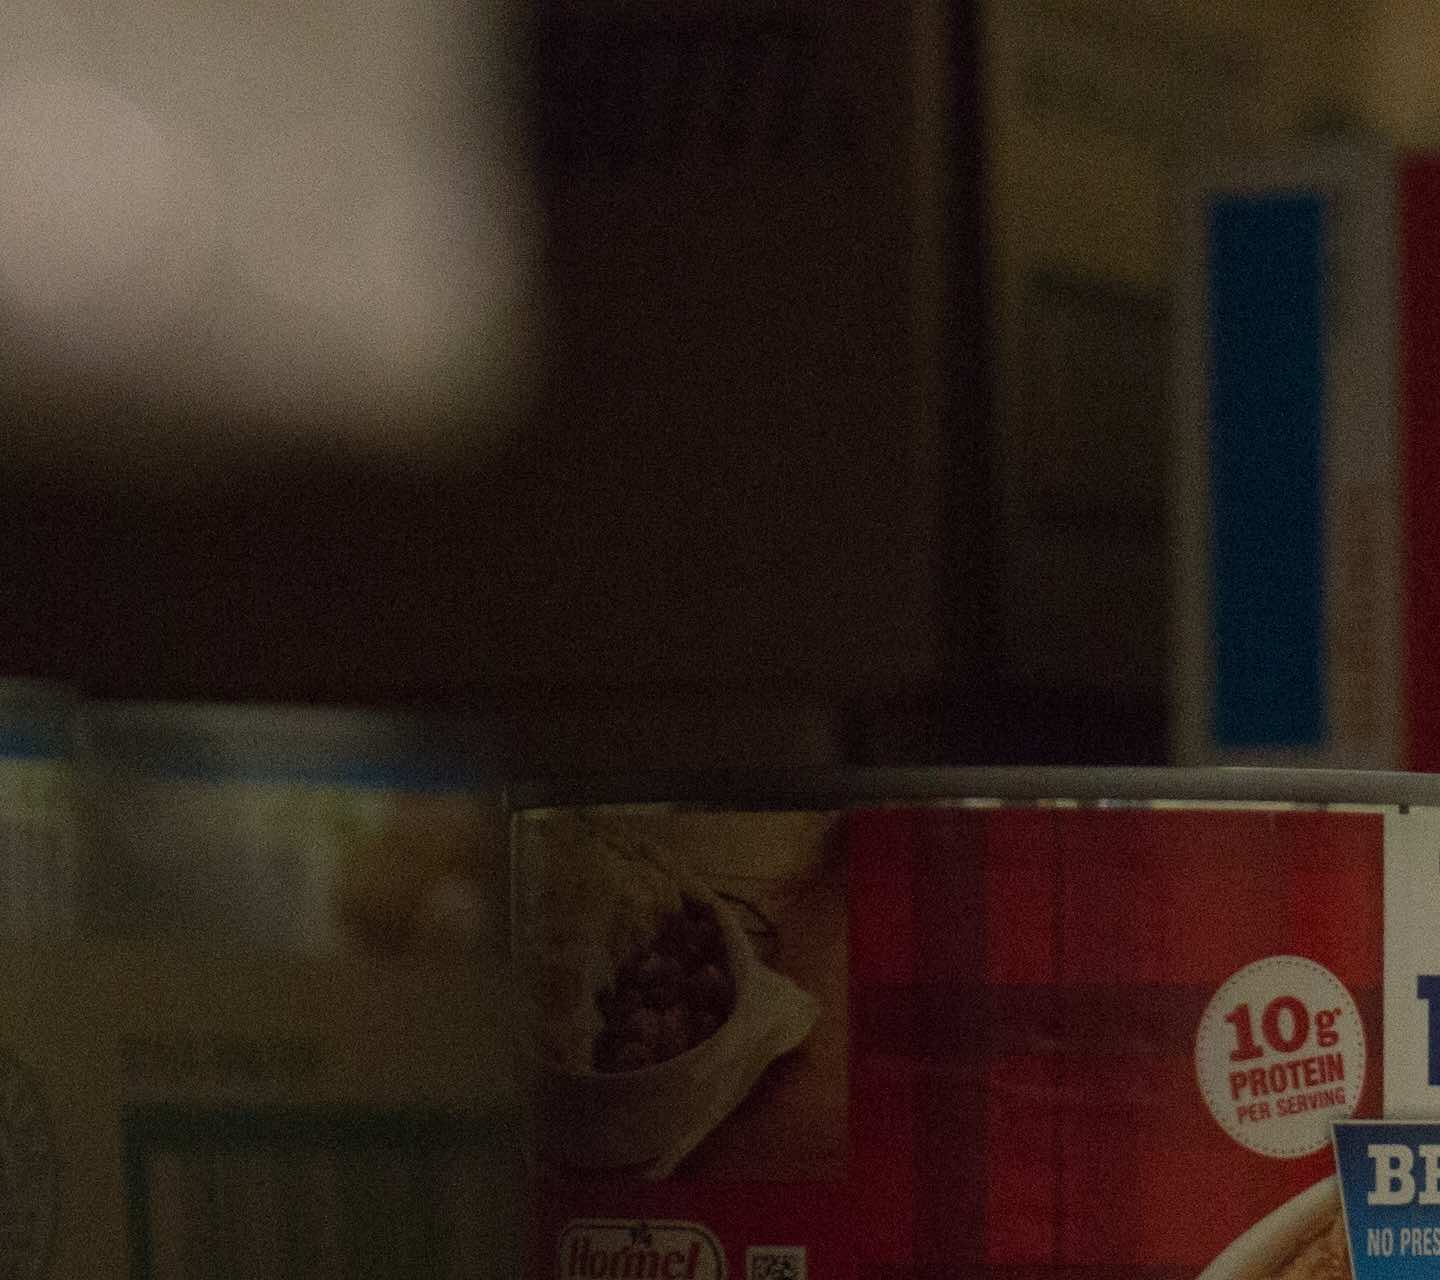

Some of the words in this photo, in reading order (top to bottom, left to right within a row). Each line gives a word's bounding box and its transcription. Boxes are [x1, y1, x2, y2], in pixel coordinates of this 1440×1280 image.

[1225, 993, 1343, 1062] 10g
[1228, 1052, 1345, 1101] PROTEIN
[1236, 1102, 1273, 1125] PER
[1275, 1087, 1347, 1118] SERVING
[568, 1237, 702, 1280] Hormel
[1365, 1227, 1395, 1259] NO
